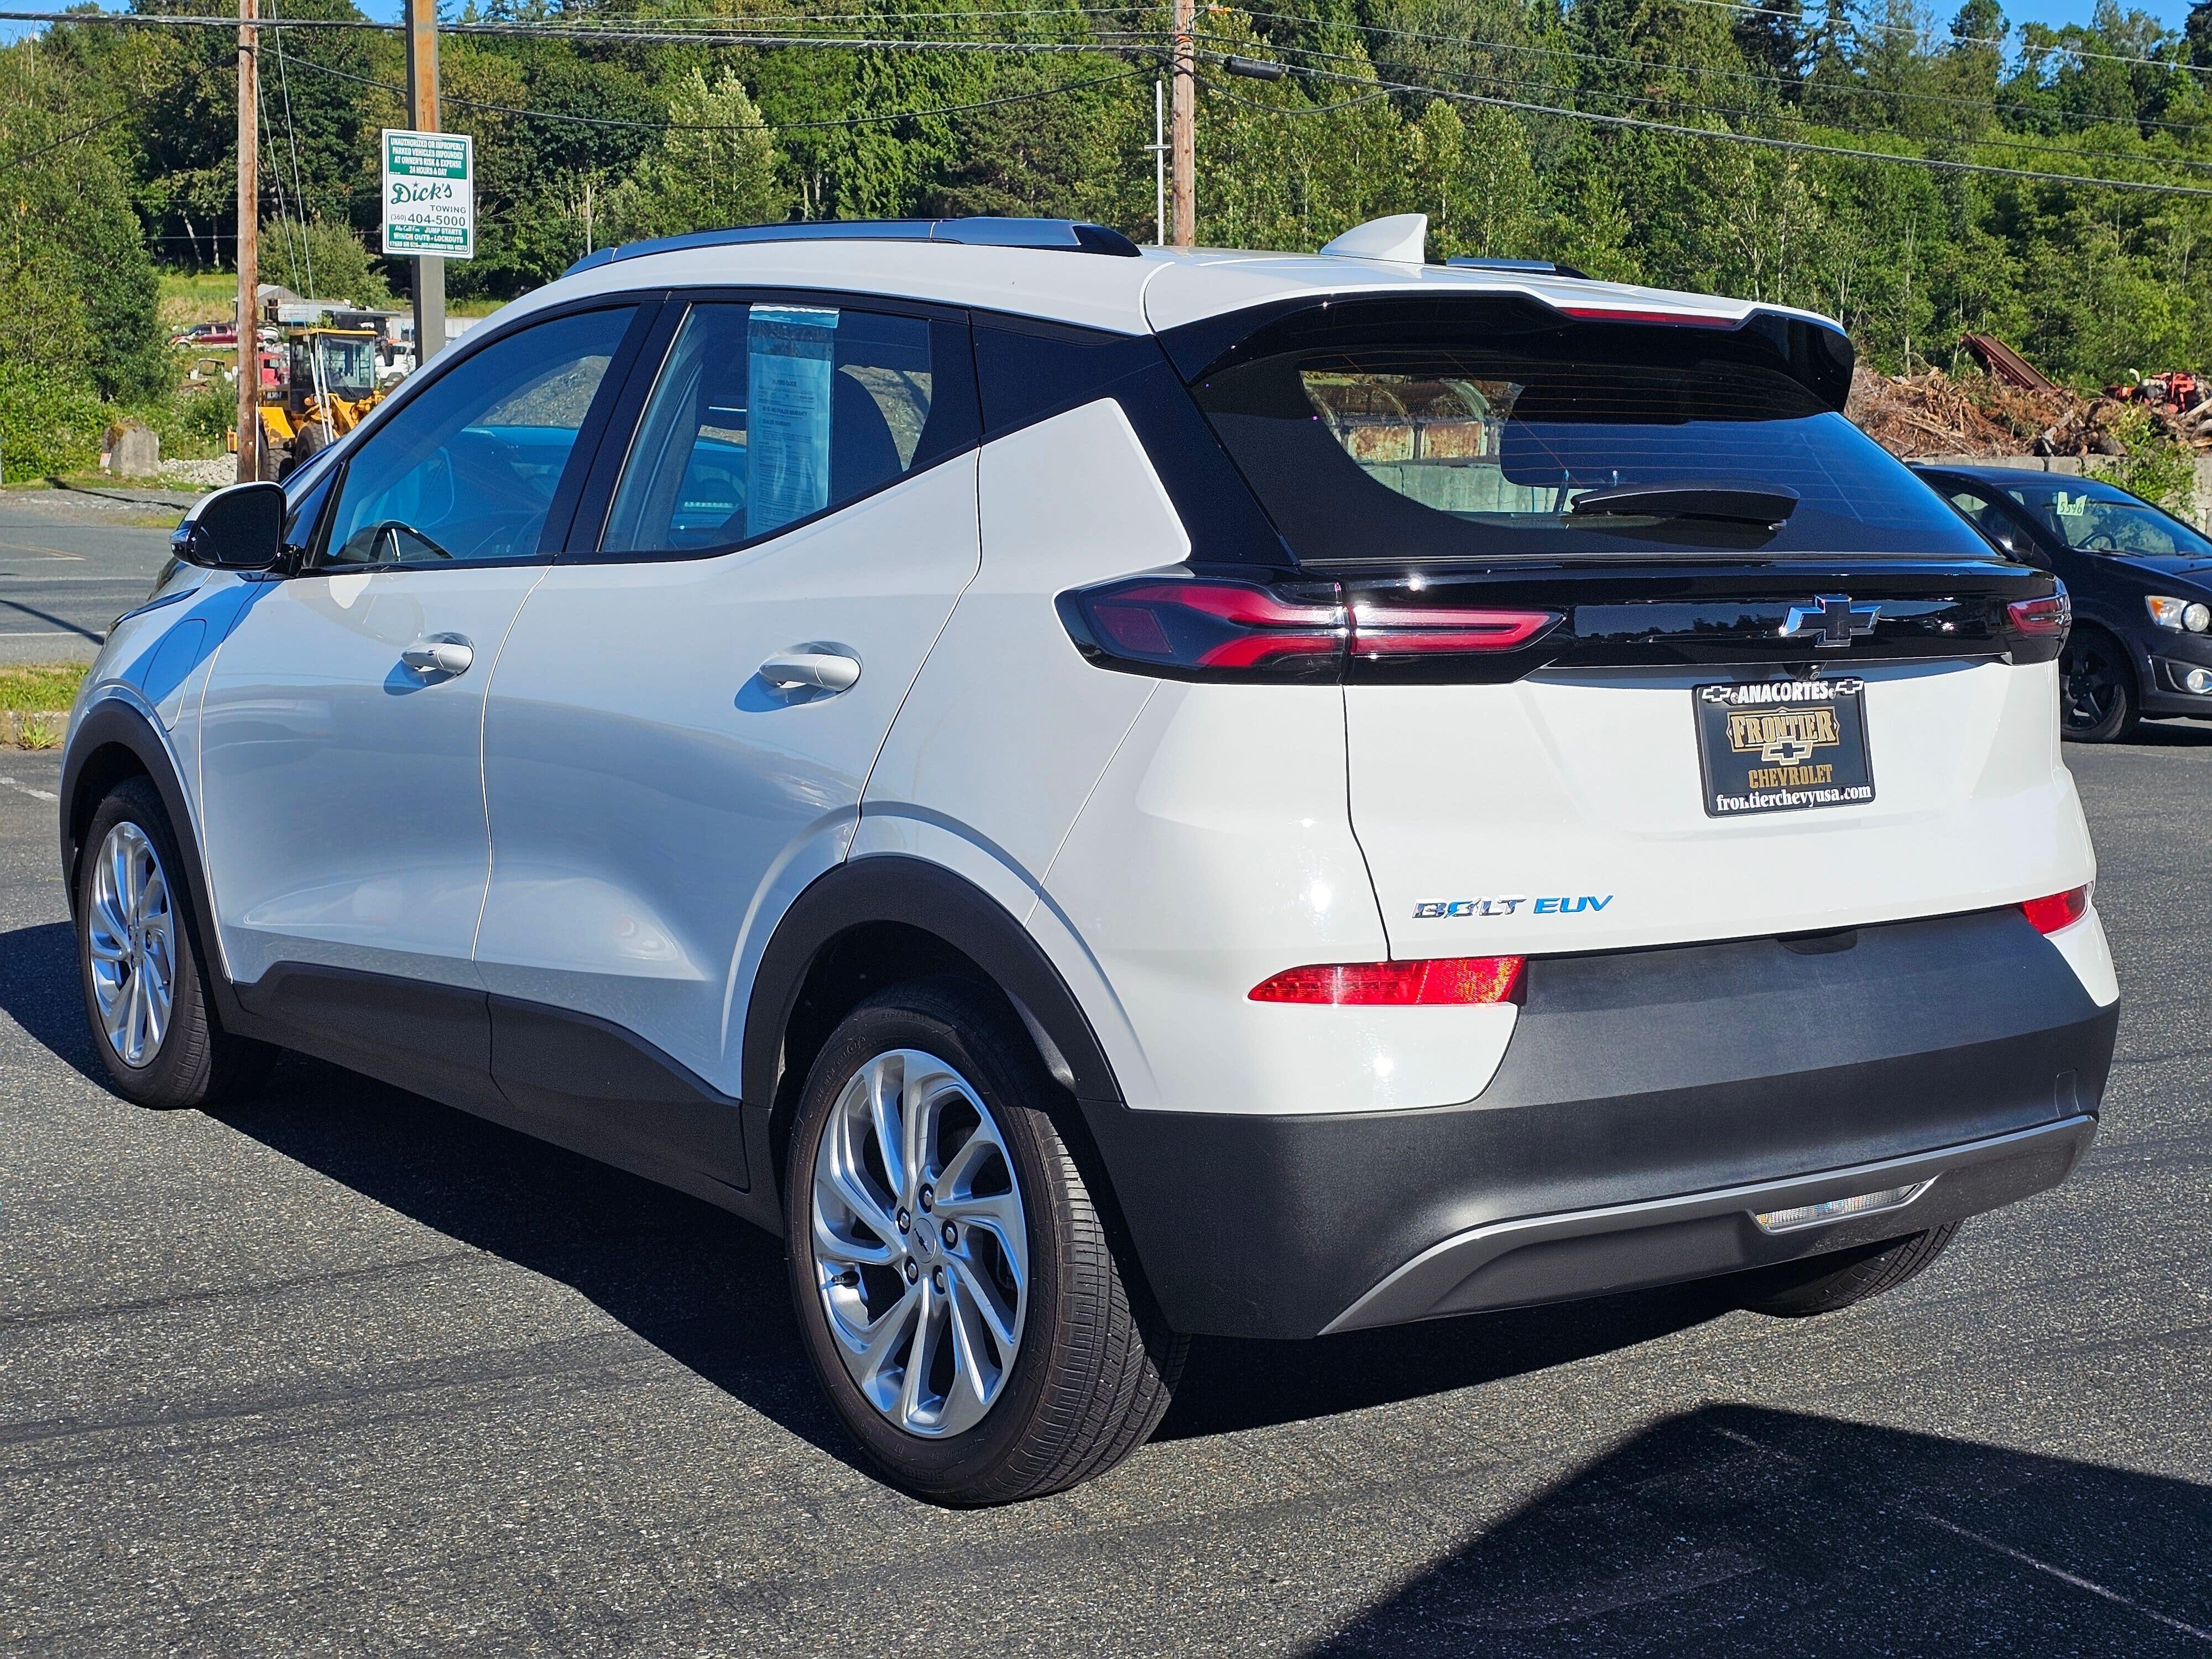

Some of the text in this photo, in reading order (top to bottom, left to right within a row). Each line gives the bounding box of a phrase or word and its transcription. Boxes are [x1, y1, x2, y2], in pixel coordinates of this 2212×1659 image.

[390, 137, 465, 151] UNAUTHORIZED OR IMPROPERLY
[392, 147, 463, 160] PARKED VEHICLES IMPOUNDED
[394, 155, 401, 164] AT
[401, 156, 423, 165] OWNER'S
[423, 157, 435, 166] RISK
[440, 159, 462, 168] EXPENSE
[409, 165, 416, 174] 24
[416, 166, 433, 175] HOURS
[437, 168, 447, 176] DAY
[390, 181, 452, 205] Dick's
[430, 205, 466, 213] TOWING
[408, 213, 466, 227] 404-5000
[414, 233, 430, 242] OUTS
[434, 234, 463, 243] LOCKOUTS
[441, 227, 462, 236] STARTS
[1736, 681, 1829, 705] ANACORTES
[1730, 711, 1837, 748] FRONTIER
[1747, 764, 1833, 789] CHEVROLET
[1715, 785, 1872, 812] frontierchevyusa.com
[1411, 894, 1614, 919] BOLT EUV
